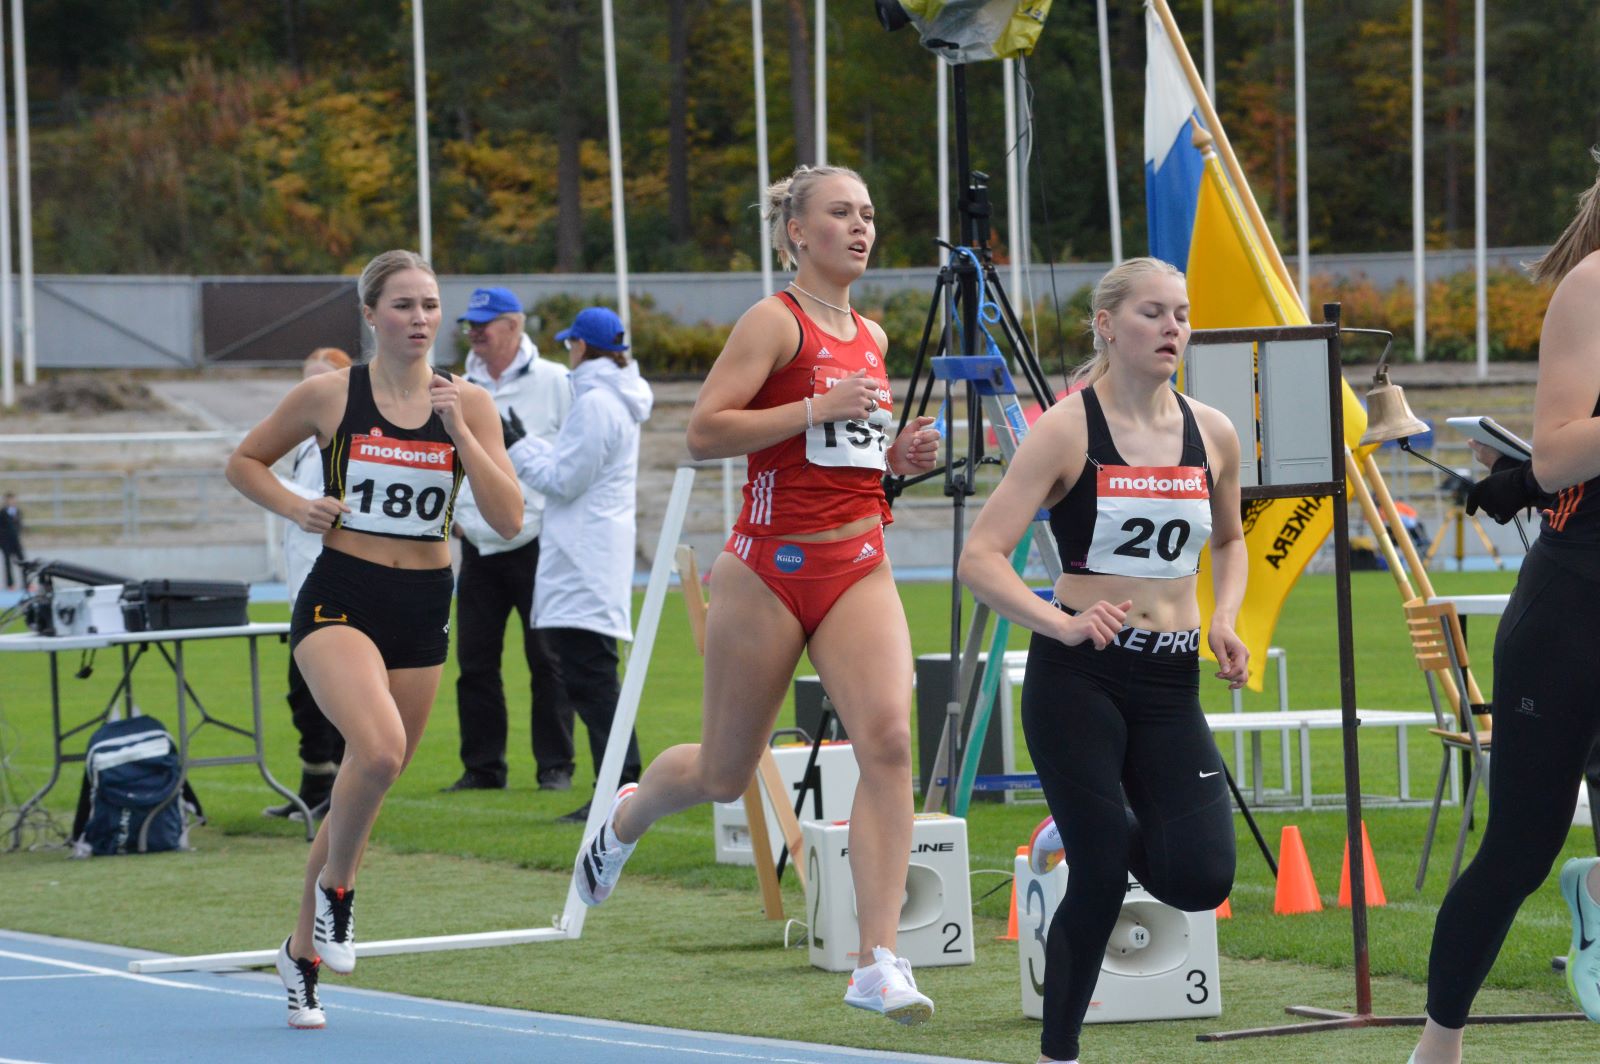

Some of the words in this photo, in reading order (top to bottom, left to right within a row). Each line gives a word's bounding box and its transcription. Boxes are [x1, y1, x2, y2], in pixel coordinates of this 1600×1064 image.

[360, 443, 447, 465] motonet
[1109, 475, 1203, 492] motonet
[351, 478, 447, 522] 180
[1112, 517, 1191, 562] 20
[1110, 624, 1151, 652] KE
[1151, 628, 1200, 654] PRO
[941, 922, 963, 954] 2
[1185, 969, 1209, 1005] 3
